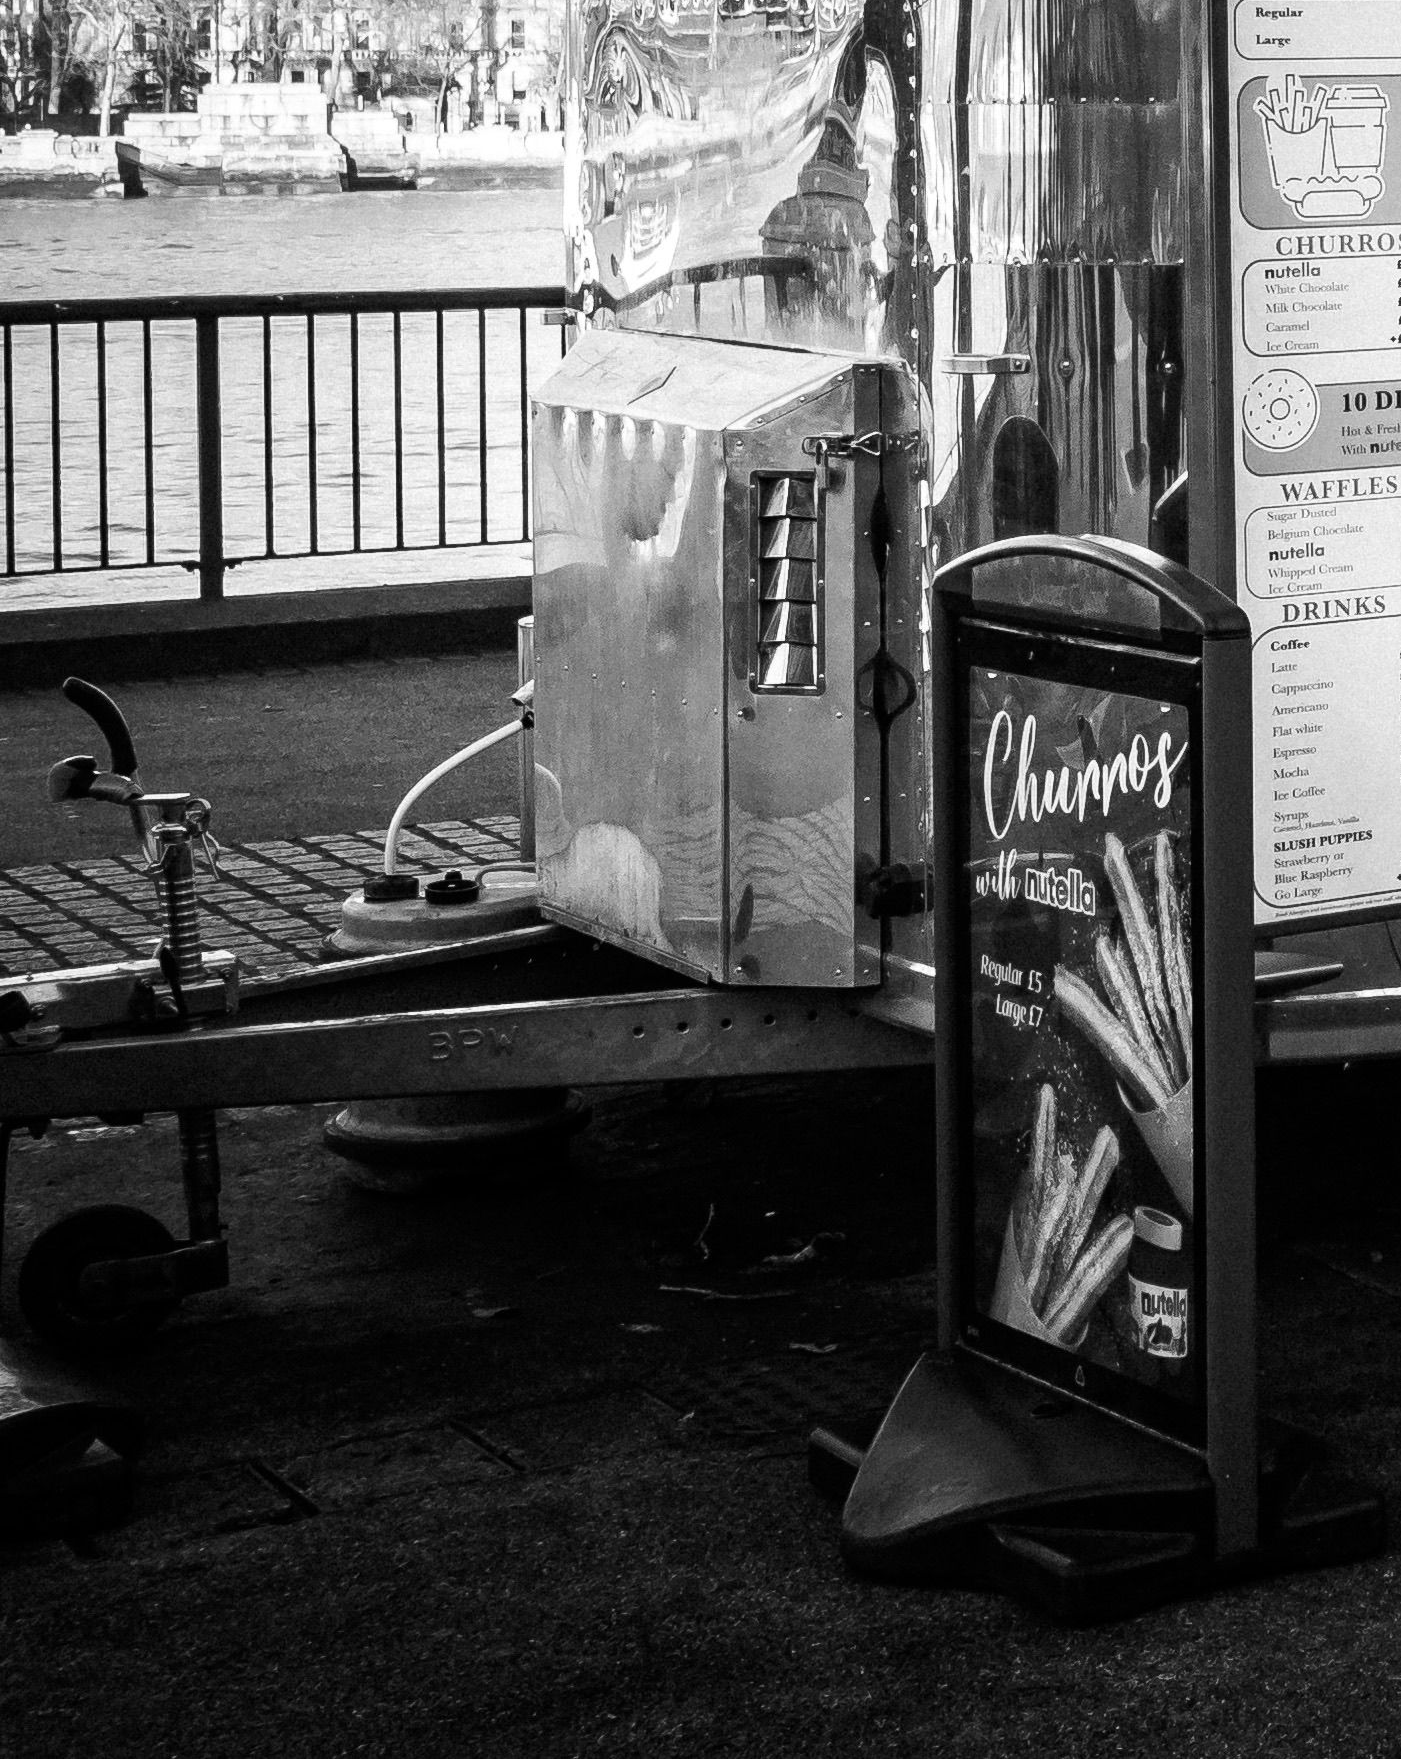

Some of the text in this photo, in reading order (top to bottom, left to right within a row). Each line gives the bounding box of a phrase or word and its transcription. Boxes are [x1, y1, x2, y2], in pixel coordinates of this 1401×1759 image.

[1255, 7, 1303, 20] Regular
[1255, 34, 1291, 47] Large
[1264, 262, 1321, 279] nutella
[1265, 281, 1349, 295] White Chocolate
[1265, 300, 1342, 313] Milk Chocolate
[1266, 321, 1310, 333] Caramel
[1266, 339, 1319, 352] Ice Cream
[1342, 392, 1367, 413] 10
[1341, 425, 1361, 438] Hot
[1365, 424, 1373, 435] &
[1341, 444, 1366, 456] With
[1280, 476, 1398, 503] WAFFLES
[1267, 506, 1337, 523] Sugar Dusted
[1268, 524, 1364, 540] Belgium Chocolate
[1269, 544, 1325, 561] nutella
[1268, 562, 1353, 580] Whipped Cream
[1282, 596, 1386, 624] DRINKS
[1270, 638, 1310, 651] Coffee
[1271, 661, 1298, 674] Latte
[1271, 679, 1334, 696] Cappuccino
[1272, 701, 1329, 716] Americano
[1273, 722, 1323, 737] Flat white
[1273, 744, 1317, 760] Espresso
[984, 711, 1188, 839] Churros
[1273, 766, 1309, 780] Mocha
[1274, 785, 1326, 801] Ice Coffee
[1274, 809, 1309, 824] Syrups
[1274, 830, 1373, 853] SLUSH PUPPIES
[1274, 851, 1344, 869] Strawberry or
[976, 848, 1096, 915] with nutella
[1275, 865, 1353, 885] Blue Raspberry
[1275, 885, 1323, 900] Go Large
[981, 955, 1042, 993] Regular £5
[996, 994, 1043, 1028] Large £7
